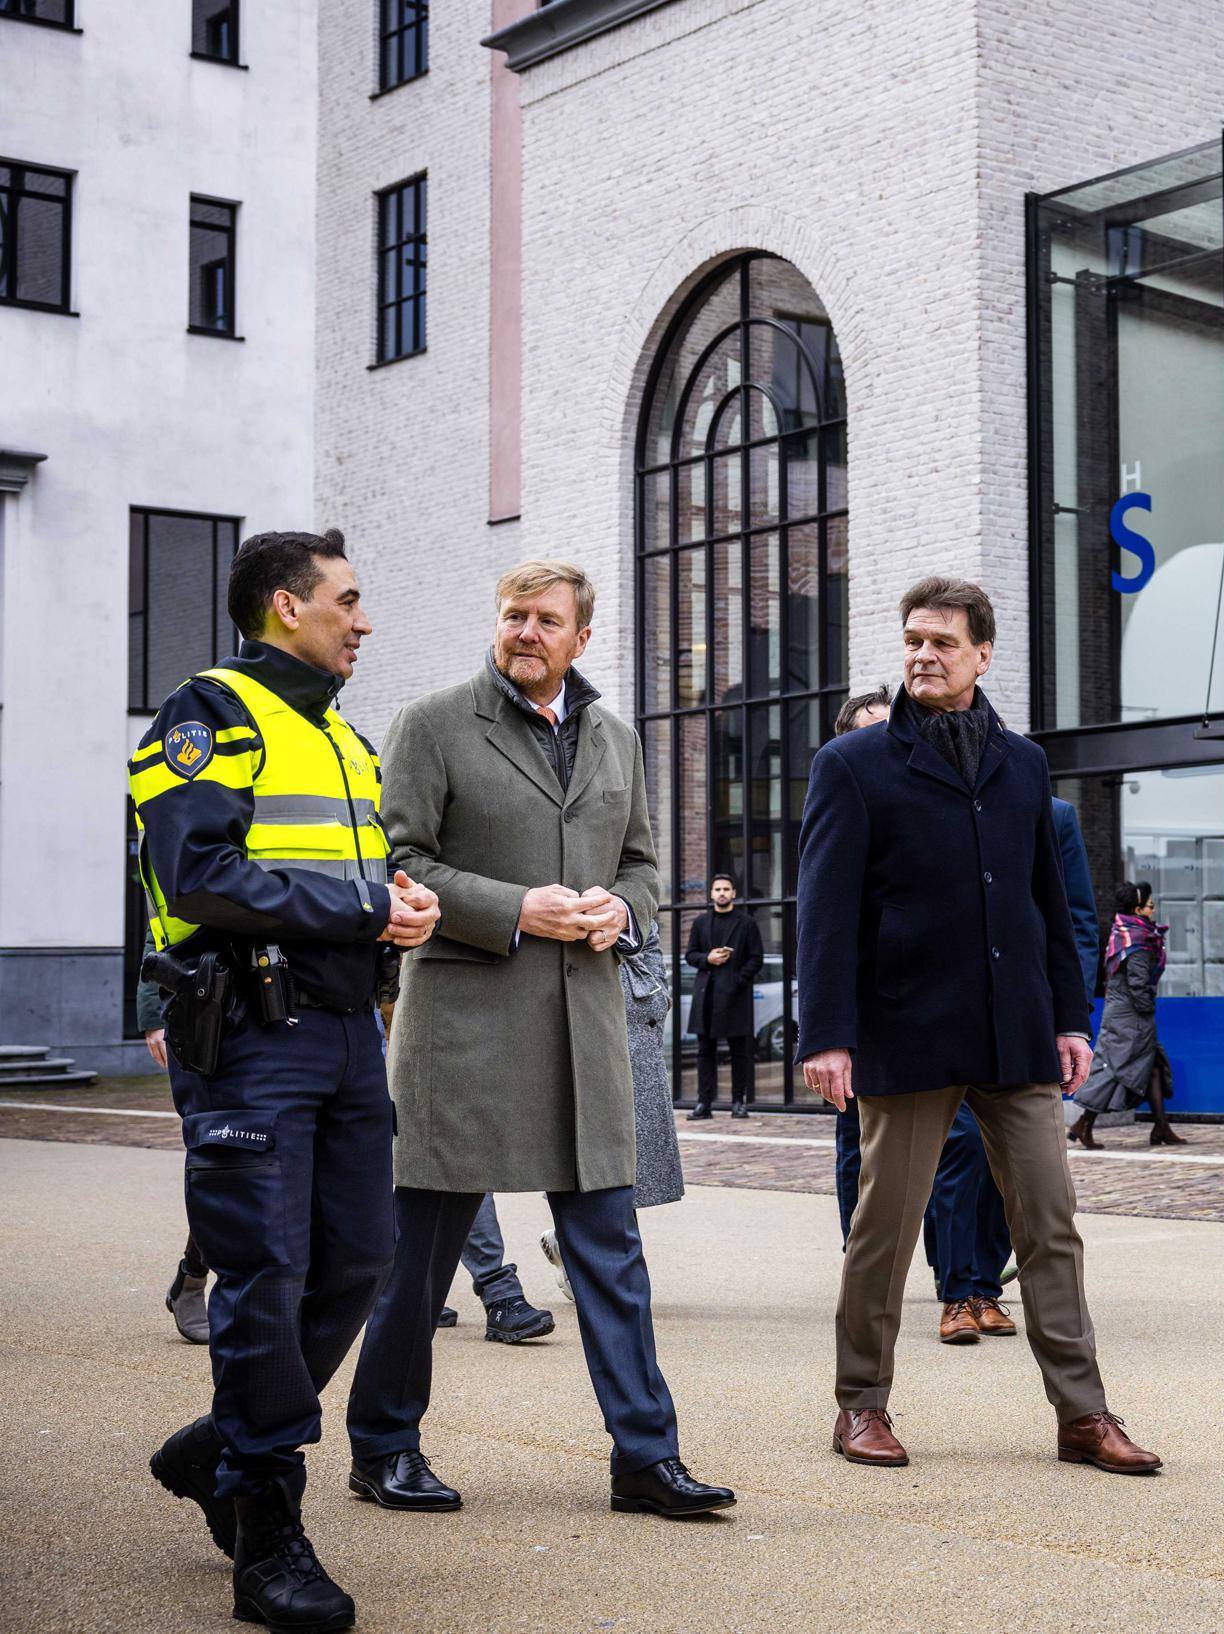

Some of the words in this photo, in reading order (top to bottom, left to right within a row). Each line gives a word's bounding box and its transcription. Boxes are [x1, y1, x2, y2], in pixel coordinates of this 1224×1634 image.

[1120, 460, 1141, 493] H
[1109, 491, 1156, 594] S
[216, 1127, 256, 1140] POLITIE
